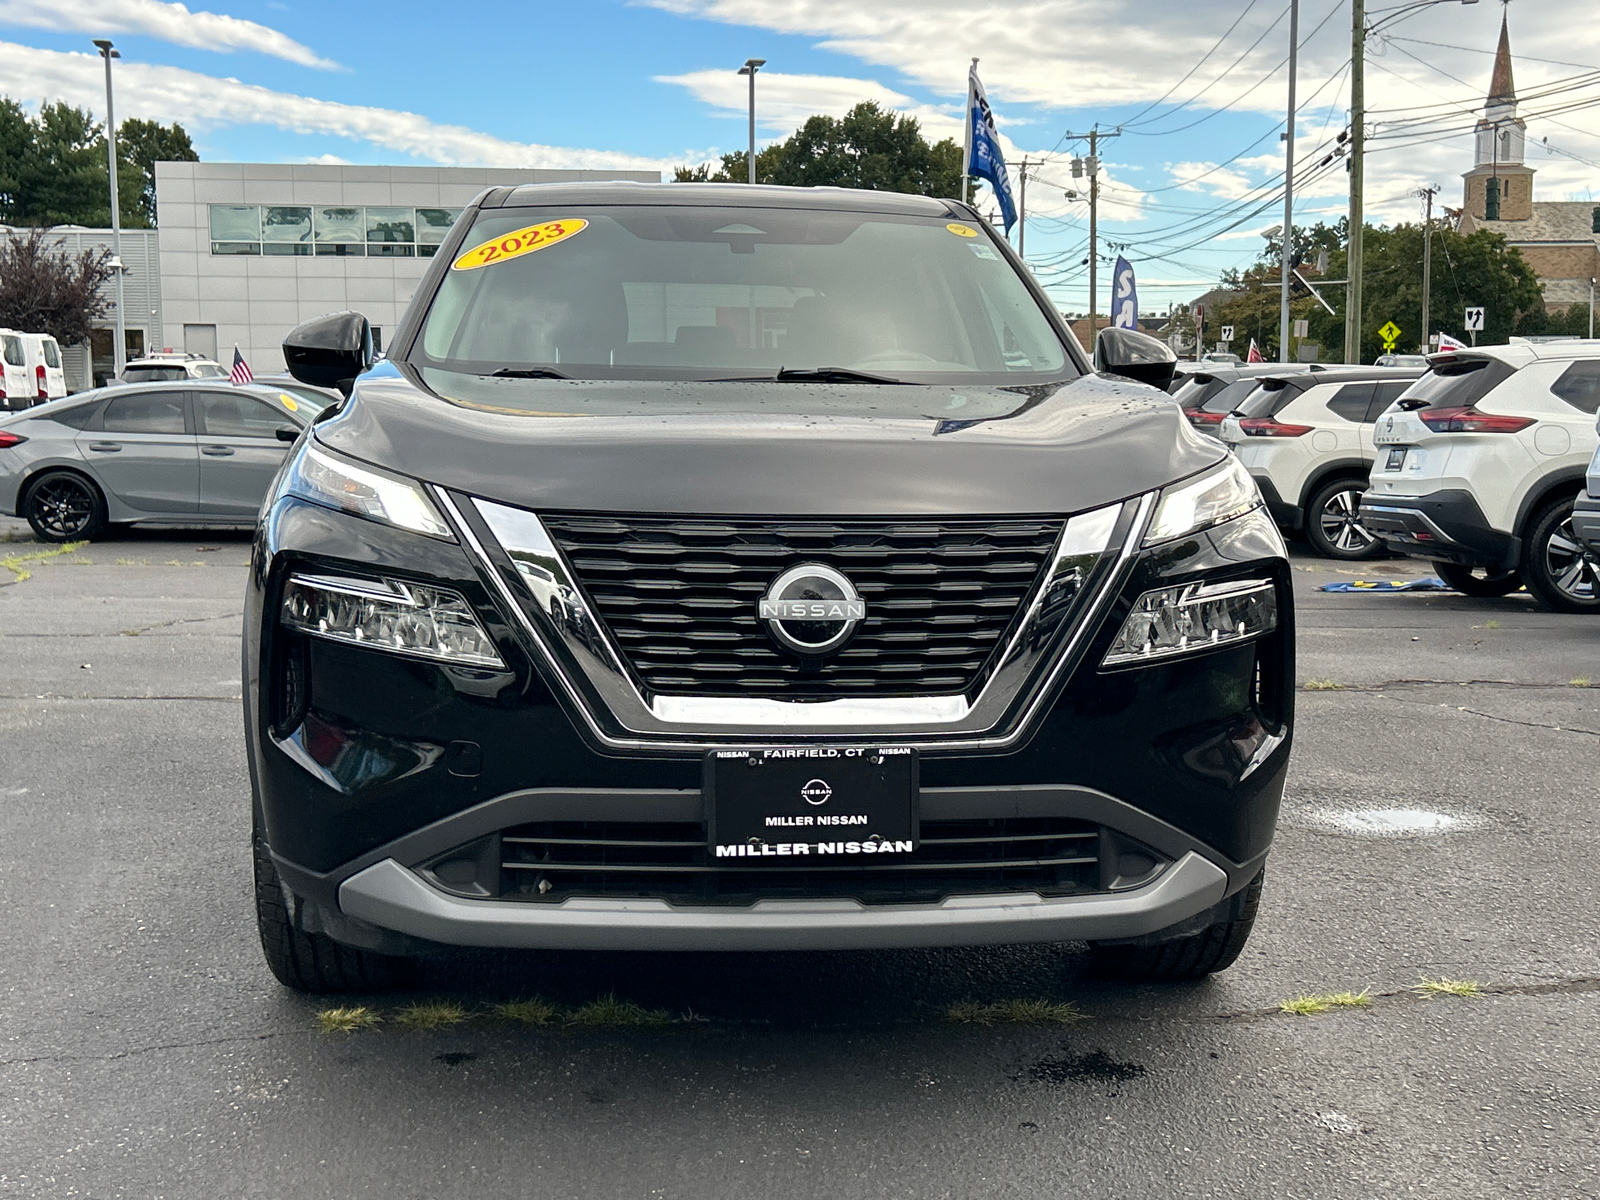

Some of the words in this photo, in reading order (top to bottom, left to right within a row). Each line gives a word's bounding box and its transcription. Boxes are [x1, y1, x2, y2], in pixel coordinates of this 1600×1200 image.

[478, 223, 566, 263] 2023
[762, 602, 864, 617] NISSAN
[763, 749, 841, 758] FAIRFIELD,
[845, 749, 865, 757] CT
[765, 816, 814, 826] MILLER
[817, 815, 868, 825] NISSAN
[715, 843, 810, 857] MILLER
[817, 841, 913, 854] NISSAN
